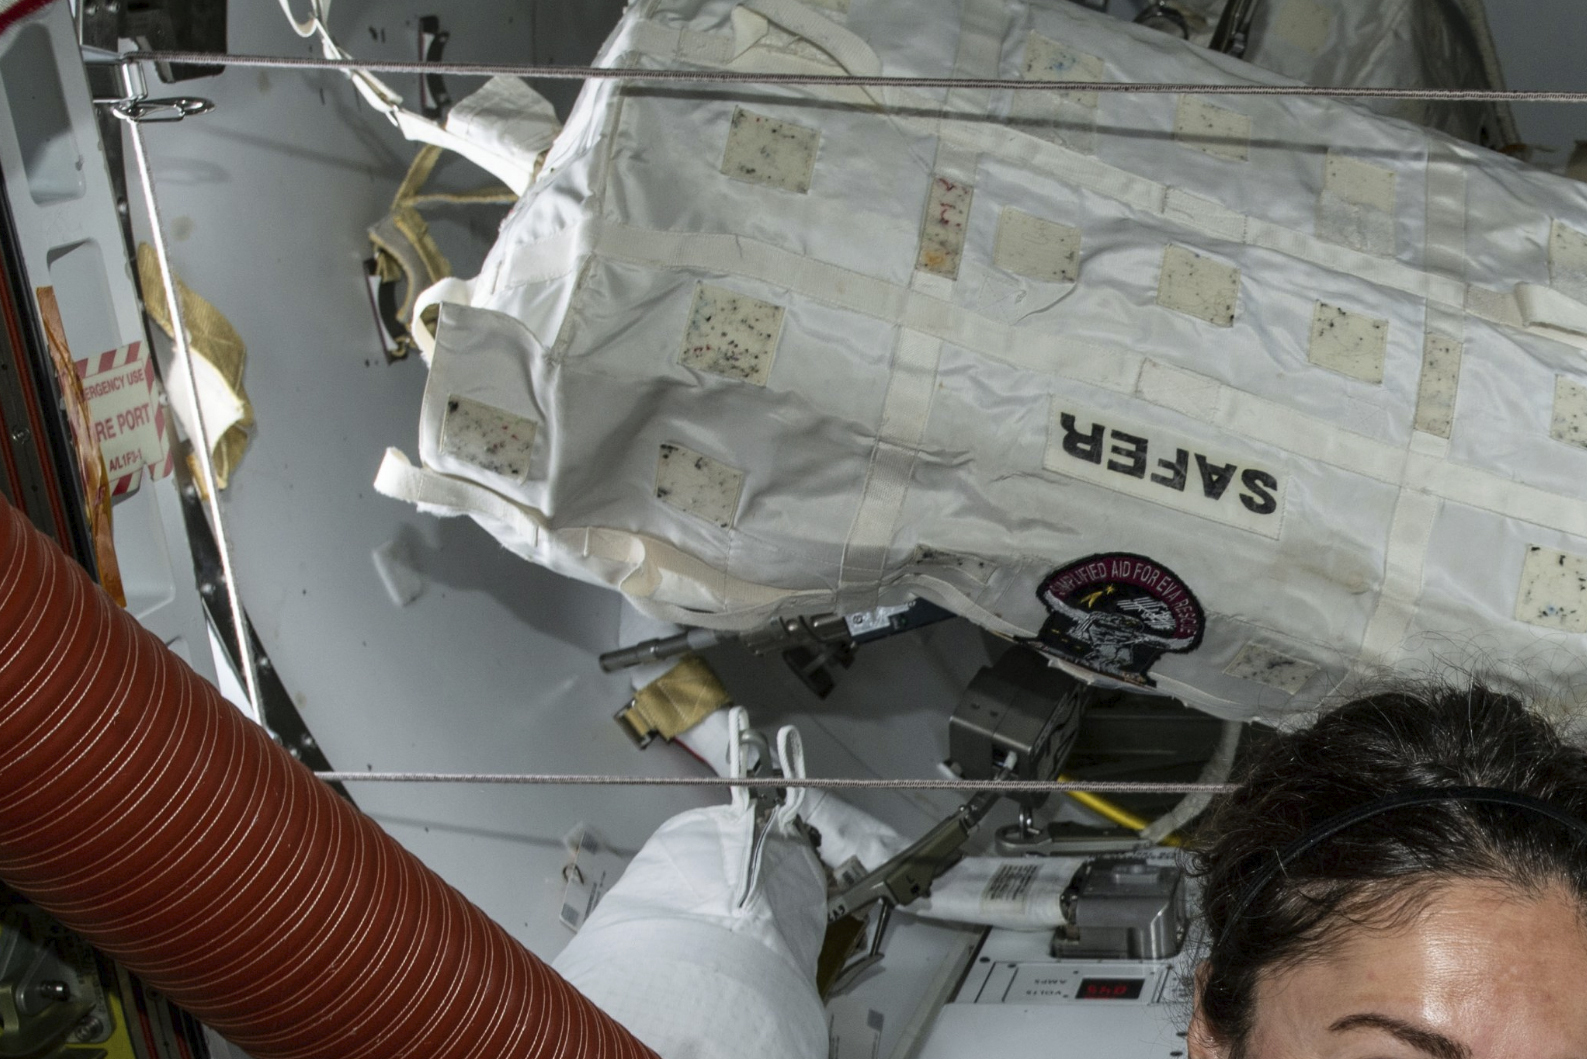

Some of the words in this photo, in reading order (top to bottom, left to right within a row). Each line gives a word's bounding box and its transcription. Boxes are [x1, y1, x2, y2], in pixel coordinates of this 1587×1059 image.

[85, 374, 125, 401] ERGENCY
[126, 368, 145, 386] USE
[94, 416, 117, 442] RE
[116, 402, 150, 435] PORT
[1060, 412, 1278, 515] SAFER
[1111, 559, 1132, 579] AID
[1132, 562, 1161, 587] FOR
[1156, 574, 1178, 602] EVA
